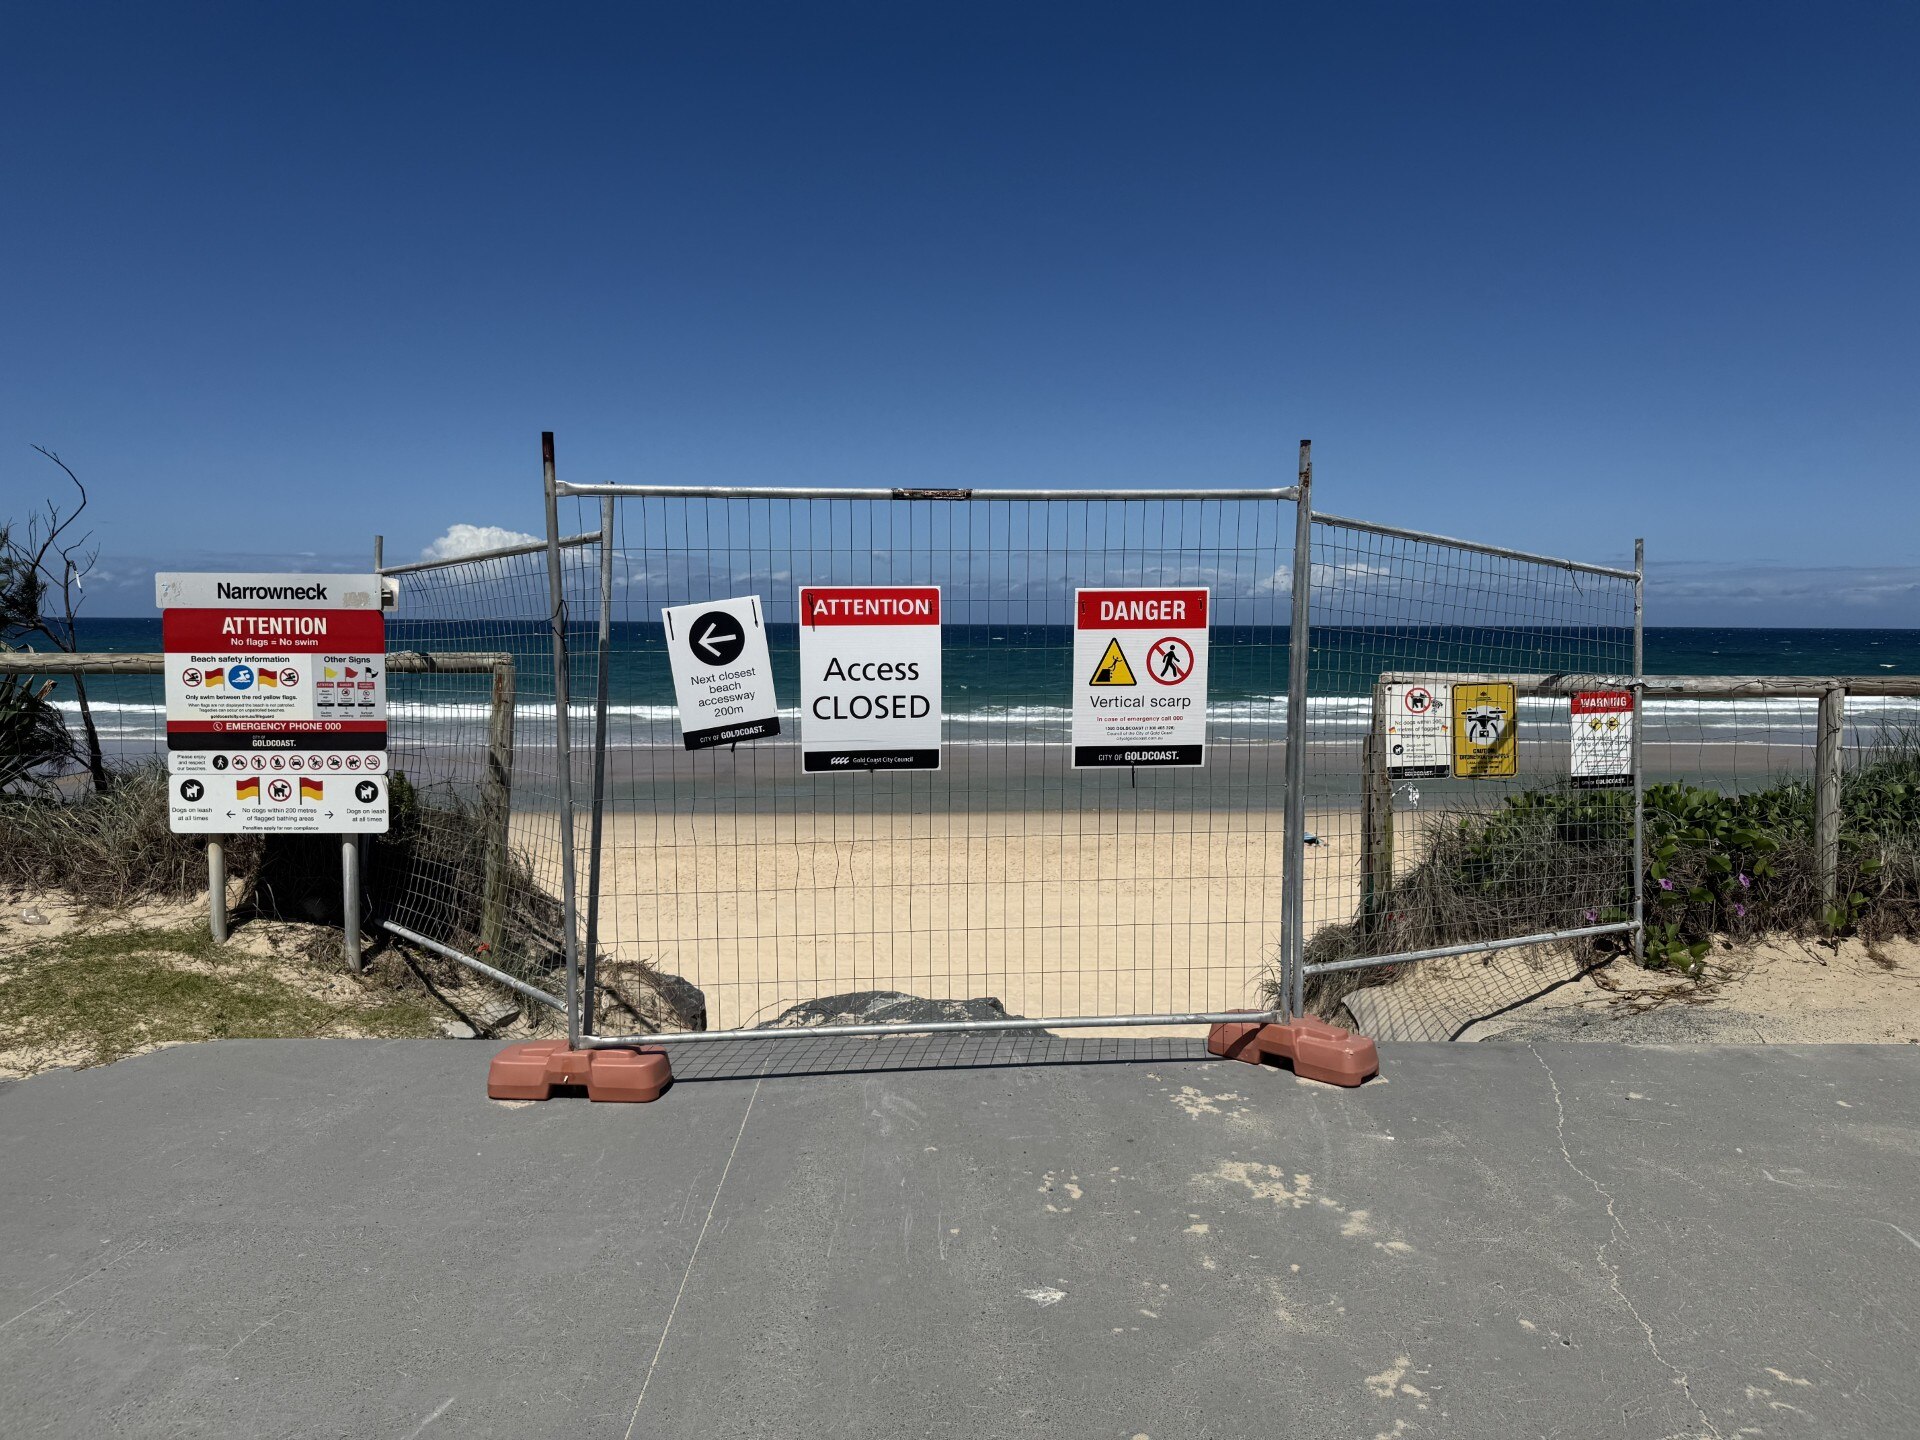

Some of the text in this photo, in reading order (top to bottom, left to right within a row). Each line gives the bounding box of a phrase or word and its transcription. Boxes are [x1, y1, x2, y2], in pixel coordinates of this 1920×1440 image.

[217, 582, 328, 601] Narrowneck
[813, 598, 930, 616] ATTENTION
[1100, 600, 1186, 621] DANGER
[222, 616, 327, 635] ATTENTION
[230, 637, 244, 646] No
[246, 637, 269, 648] flags
[279, 638, 293, 646] No
[294, 638, 319, 646] swim
[190, 655, 290, 664] Beach safety information
[323, 656, 371, 665] Other Signs
[823, 657, 920, 682] Access
[690, 667, 756, 686] Next closest
[708, 681, 742, 694] beach
[698, 691, 756, 707] accessway
[1089, 695, 1191, 710] Vertical scarp
[1581, 697, 1627, 708] WARNING
[714, 705, 744, 718] 200m
[812, 694, 930, 720] CLOSED
[226, 722, 342, 731] EMERGENCY PHONE 000
[252, 739, 297, 747] GOLDCOAST.
[882, 756, 894, 764] City
[1098, 751, 1180, 762] CITY OF GOLDCOAST.
